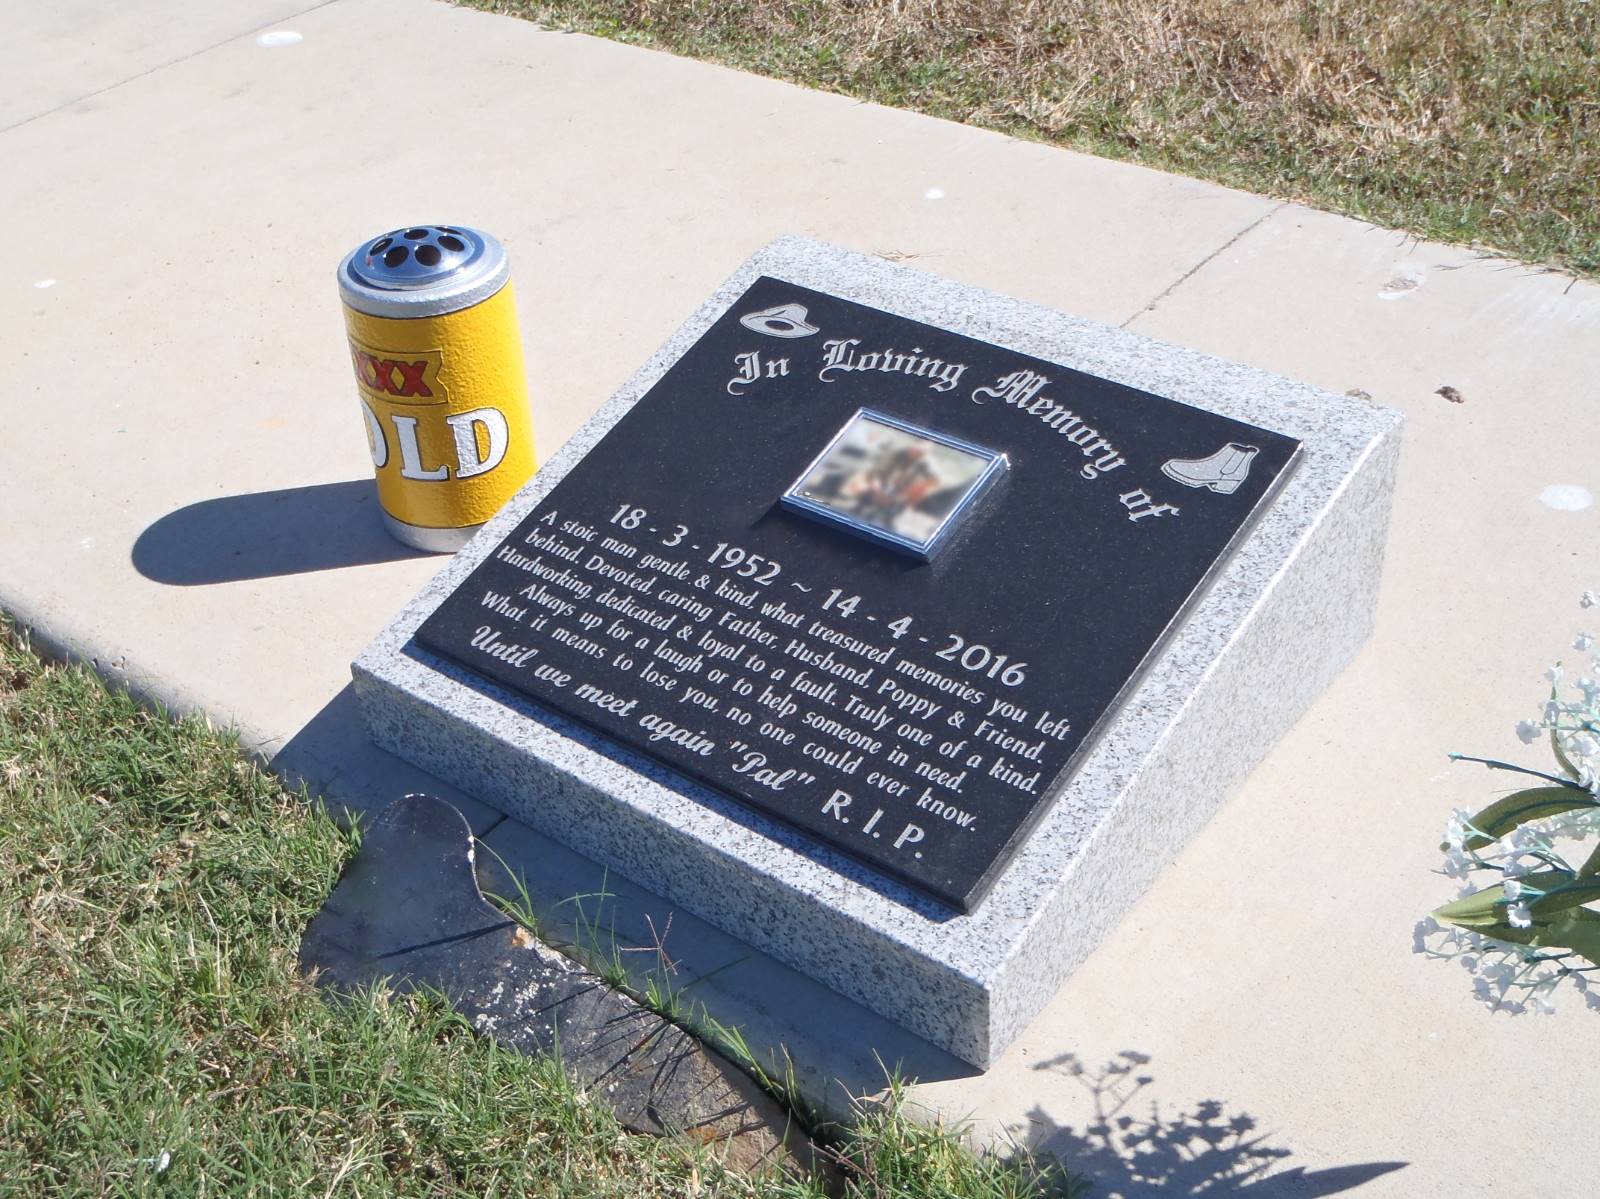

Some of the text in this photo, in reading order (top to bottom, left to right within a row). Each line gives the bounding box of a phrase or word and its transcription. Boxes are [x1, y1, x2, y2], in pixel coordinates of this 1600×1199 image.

[727, 338, 1181, 523] In Loving Memory of
[480, 591, 977, 832] What it means to lose you, no one could ever know.
[497, 545, 1042, 795] Hardworking, dedicated & loyal to a fault. Truly one of a kind.
[519, 583, 967, 794] Always up for a laugh or to help someone in need.
[524, 528, 1044, 764] behind. Devoted, caring Father, Husband, Poppy & Friend.
[540, 510, 1072, 741] A stoic man gentle & kind, what treasured memories you left
[610, 504, 647, 531] 18
[663, 524, 689, 548] 3
[707, 542, 782, 586] 1952
[821, 588, 862, 618] 14
[888, 615, 913, 638] 4
[936, 634, 1029, 687] 2016
[470, 625, 538, 669] Until
[534, 661, 572, 688] we
[575, 681, 639, 717] meet
[638, 713, 715, 757] again
[821, 789, 852, 823] R.
[862, 808, 884, 838] I.
[893, 822, 925, 859] P.
